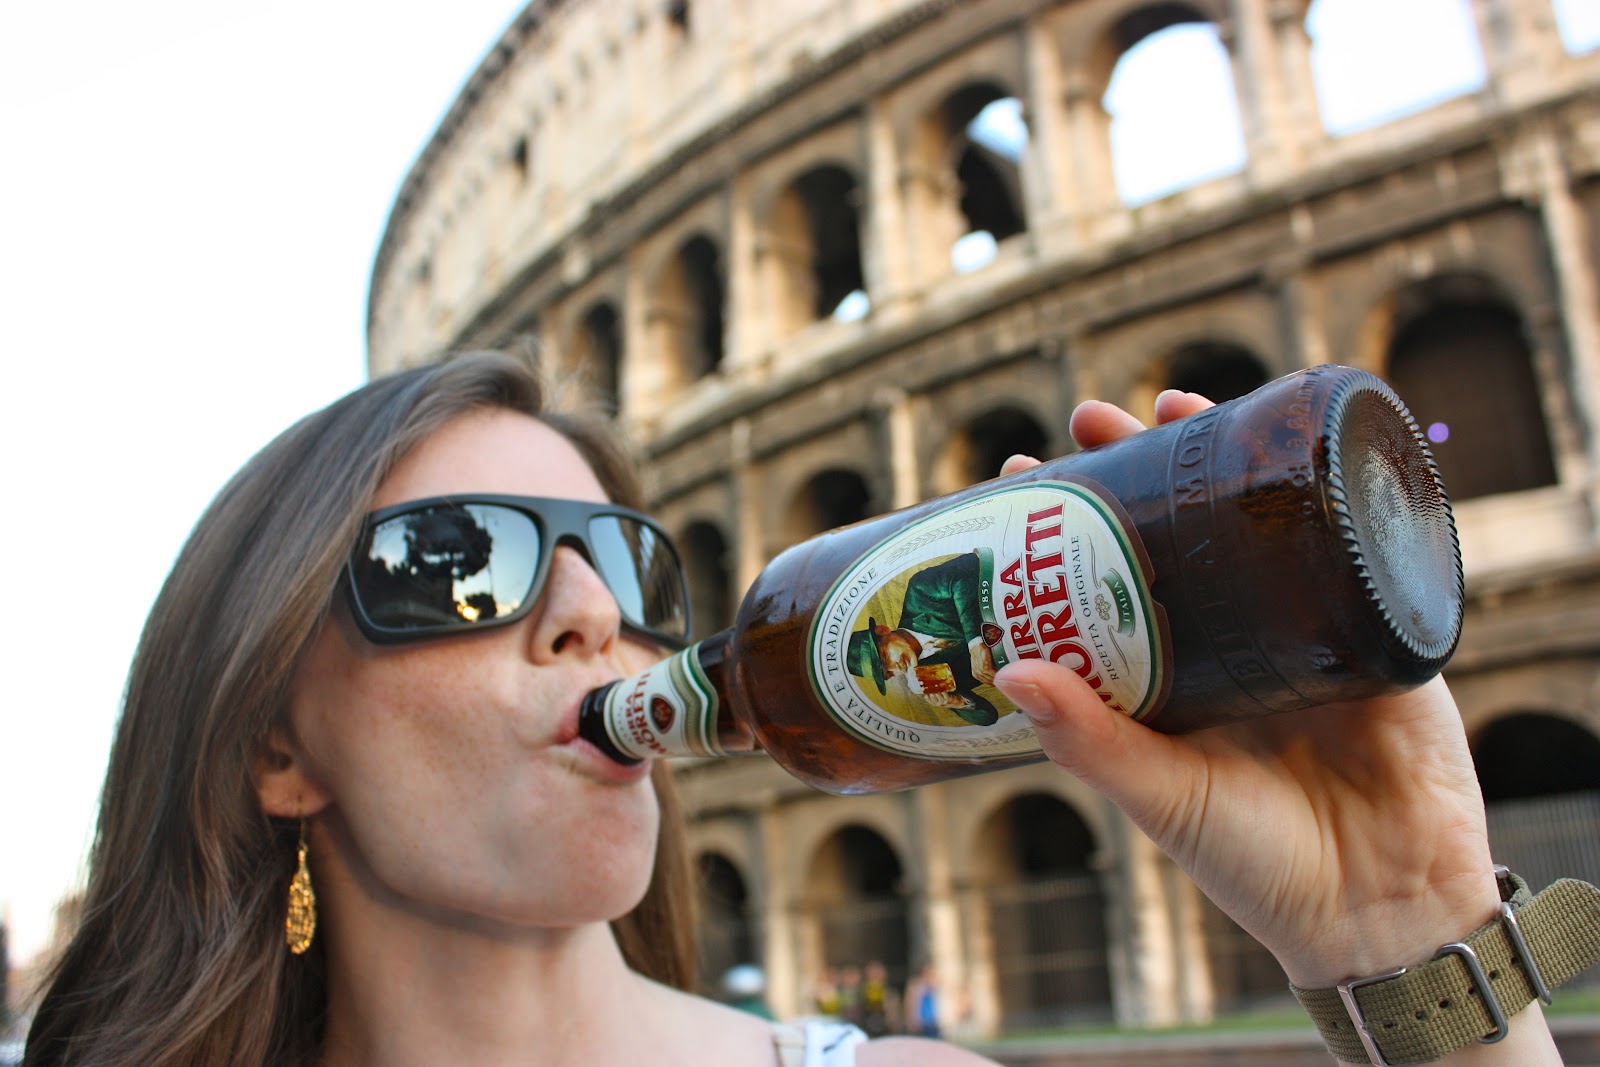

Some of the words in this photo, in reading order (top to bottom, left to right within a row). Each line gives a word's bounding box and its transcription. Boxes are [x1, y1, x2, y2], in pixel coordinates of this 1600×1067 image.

[981, 580, 990, 610] 1859
[1071, 535, 1093, 618] ORIGINALE
[1113, 583, 1130, 622] ITALIA
[827, 567, 879, 674] TRADIZIONE
[1000, 558, 1043, 660] IRRA
[1088, 623, 1120, 681] RICETTA
[834, 681, 846, 694] E
[625, 693, 644, 745] BIRRA
